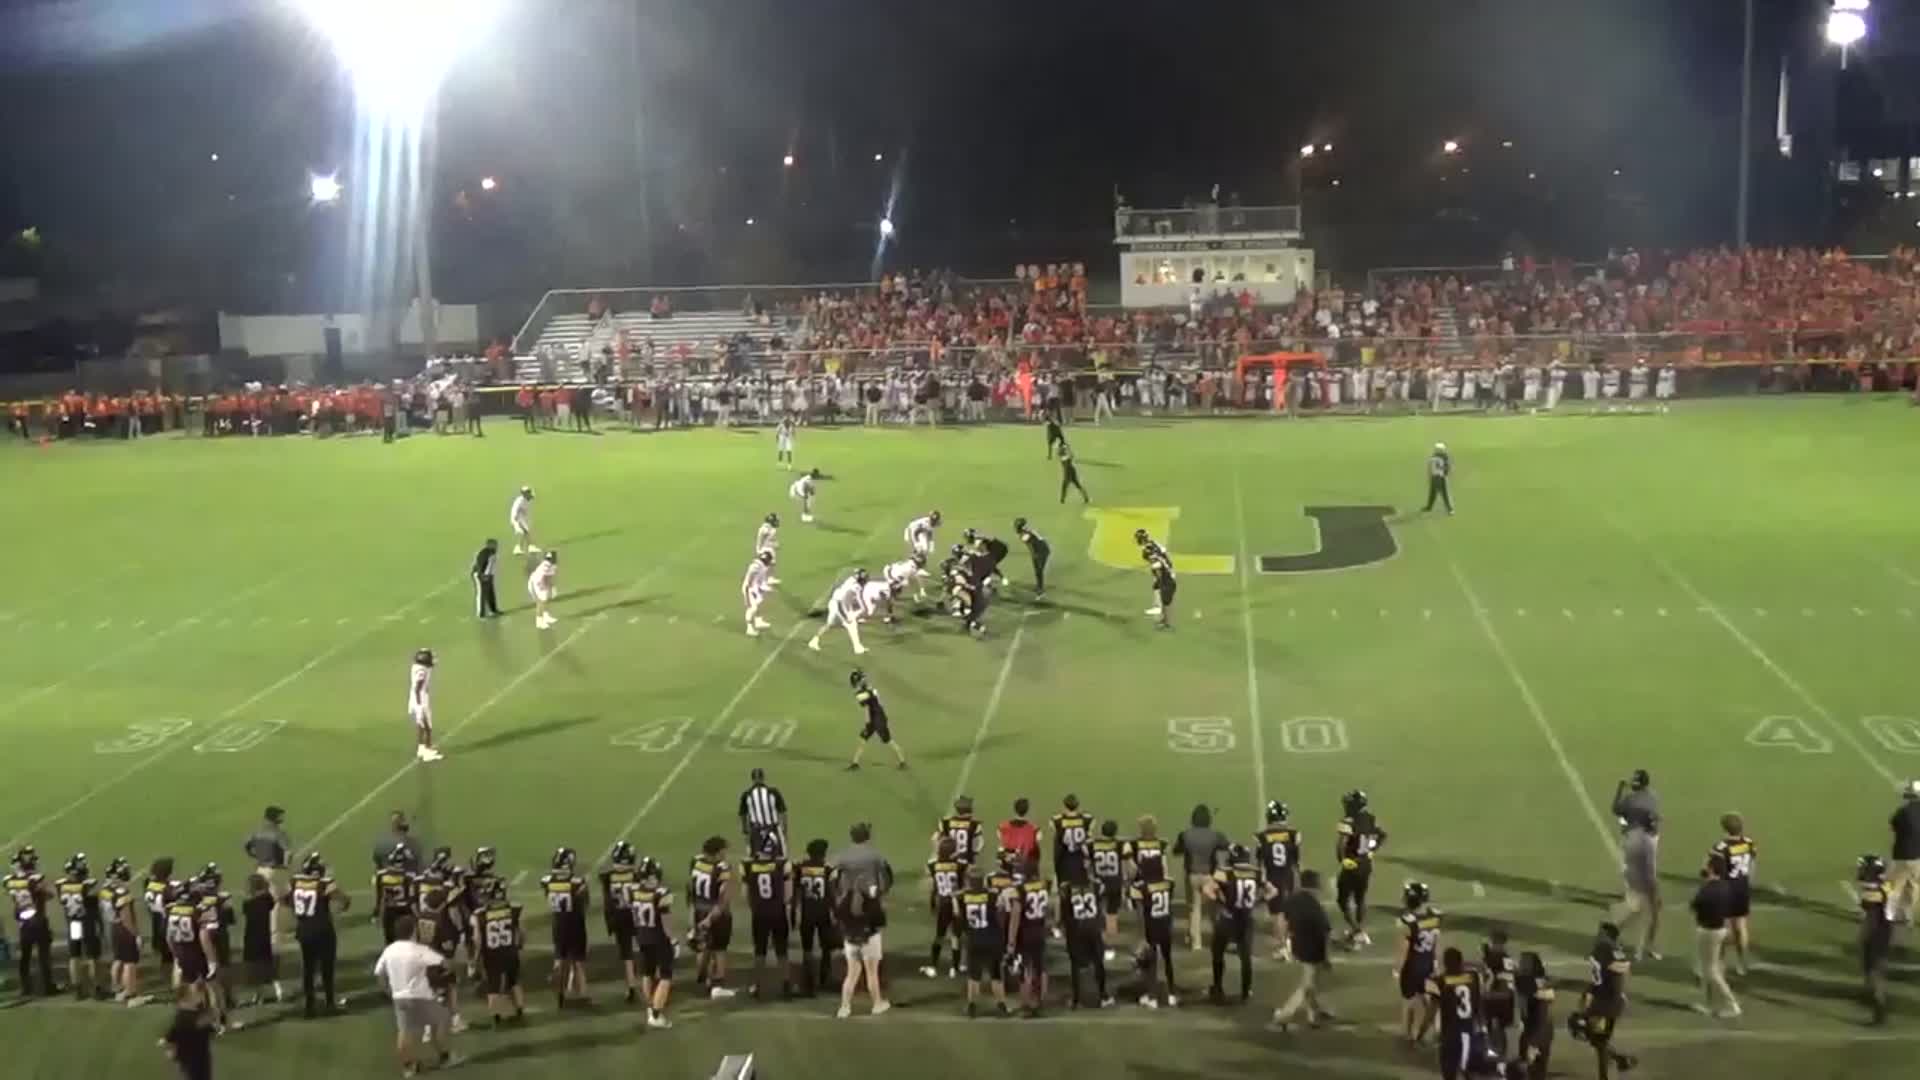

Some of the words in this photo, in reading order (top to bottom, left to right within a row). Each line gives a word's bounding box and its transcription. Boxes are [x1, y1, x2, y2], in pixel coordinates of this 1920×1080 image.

[1272, 842, 1287, 867] 9
[758, 873, 772, 899] 8
[1235, 878, 1256, 909] 13
[293, 888, 317, 916] 67
[1025, 890, 1048, 920] 32
[1071, 893, 1097, 919] 23
[1151, 891, 1169, 917] 21
[966, 904, 989, 929] 51
[486, 919, 513, 949] 65
[1455, 985, 1472, 1019] 3
